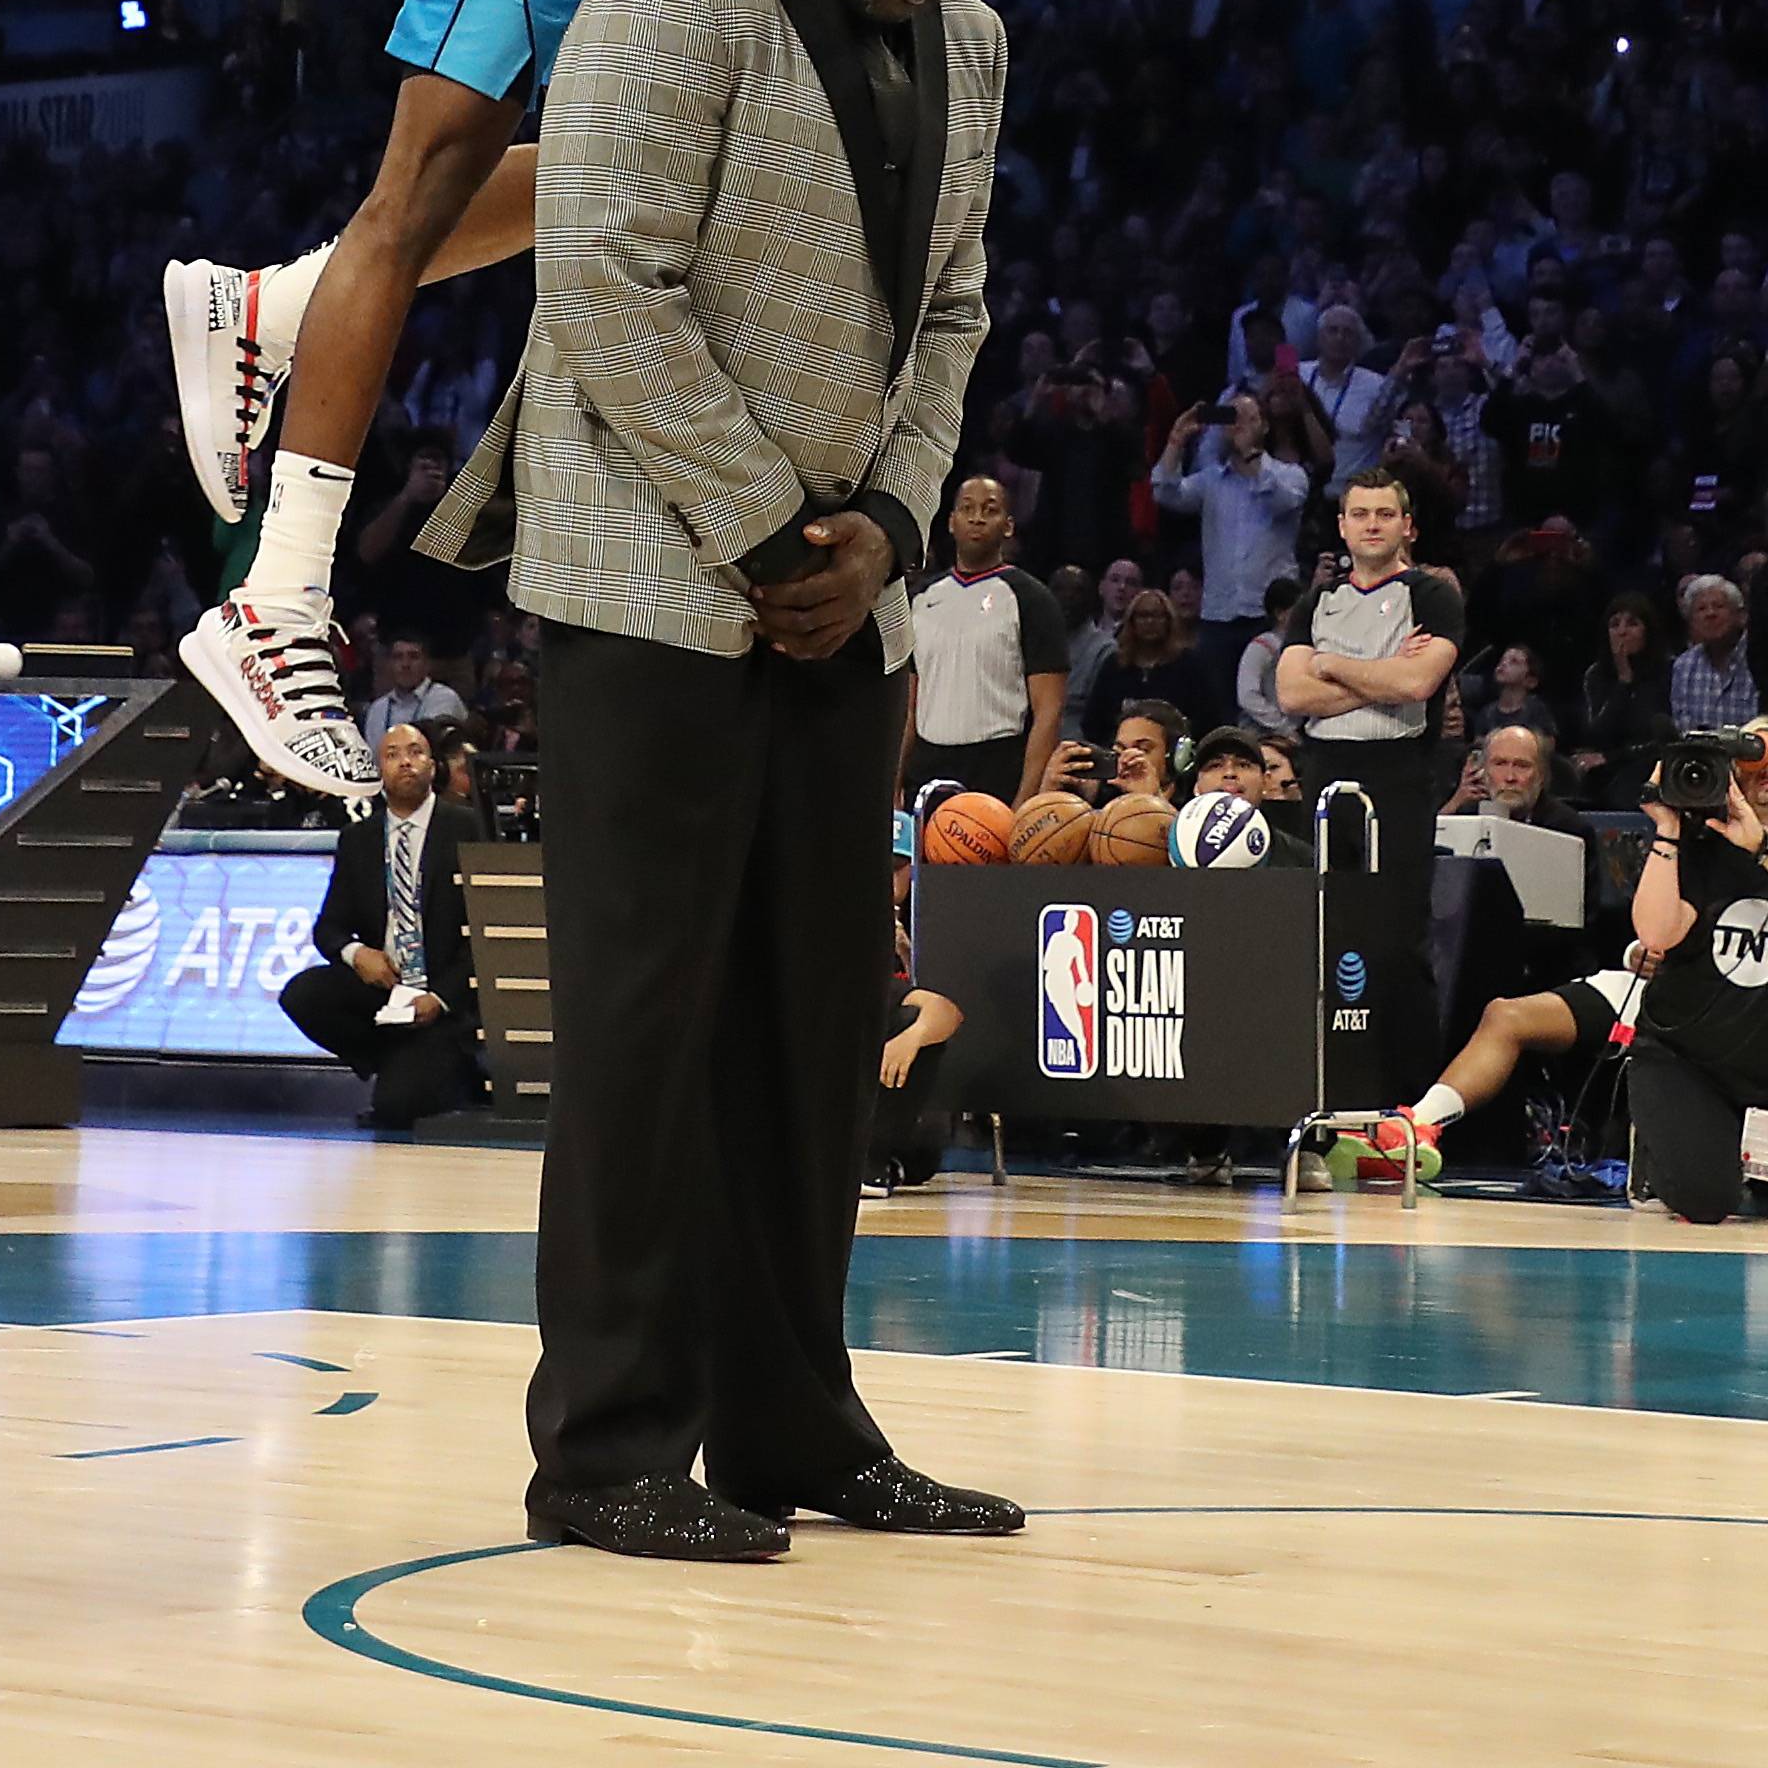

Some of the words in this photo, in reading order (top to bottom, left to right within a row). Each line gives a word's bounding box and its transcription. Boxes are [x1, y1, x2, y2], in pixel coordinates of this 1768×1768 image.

[163, 907, 325, 992] AT&
[1137, 917, 1184, 939] AT&T
[1106, 949, 1185, 1015] SLAM
[1333, 1009, 1370, 1031] AT&T
[1047, 1038, 1076, 1066] NBA
[1106, 1016, 1185, 1079] DUNK
